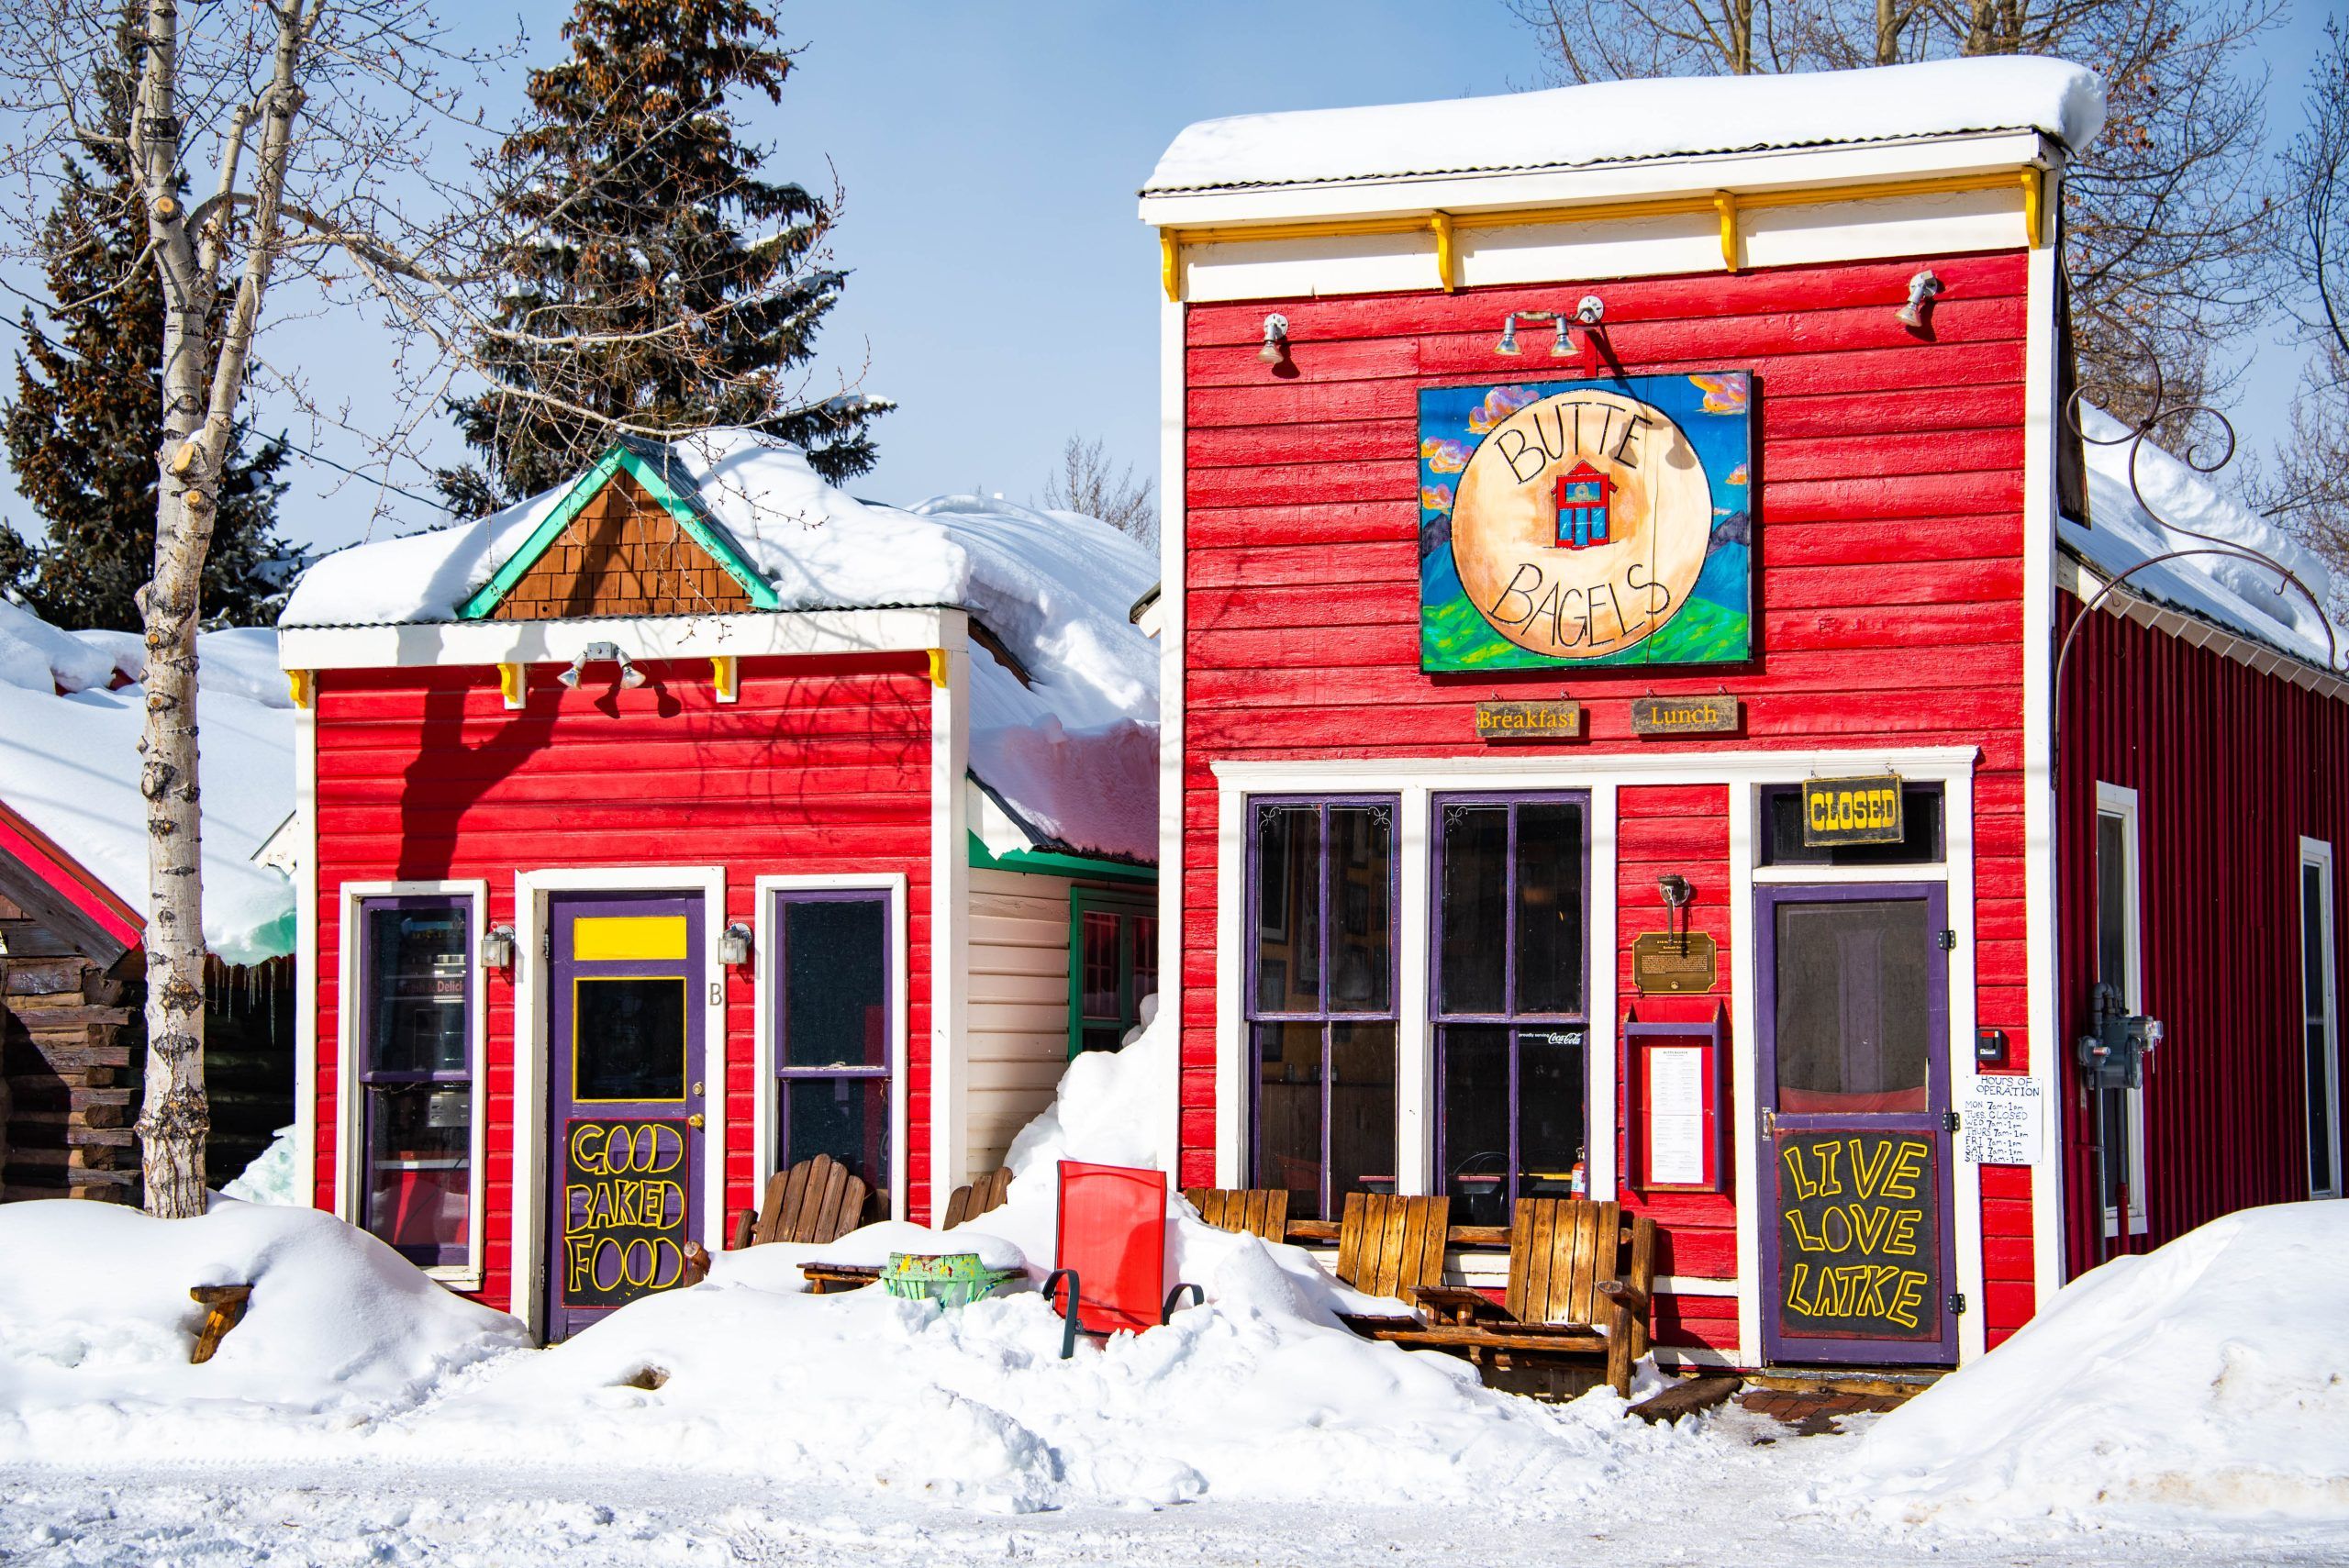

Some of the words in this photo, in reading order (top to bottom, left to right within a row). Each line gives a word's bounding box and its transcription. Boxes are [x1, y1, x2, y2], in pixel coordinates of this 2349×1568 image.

[1495, 401, 1653, 484] BUTTE
[1487, 562, 1671, 648] BAGELS
[1478, 710, 1576, 730] Breakfast
[1651, 705, 1719, 726] Lunch
[1809, 788, 1897, 831] CLOSED
[437, 980, 464, 993] Delici
[708, 982, 723, 1006] B
[1976, 1084, 2040, 1096] OPERATION
[2017, 1077, 2032, 1086] OF
[1988, 1110, 2028, 1120] CLOSED
[571, 1124, 684, 1175] GOOD
[1965, 1136, 1983, 1146] FRI
[1784, 1139, 1928, 1202] LIVE
[565, 1179, 685, 1234] BAKED
[1785, 1203, 1923, 1256] LOVE
[564, 1233, 684, 1293] FOOD
[1787, 1263, 1928, 1329] LATKE
